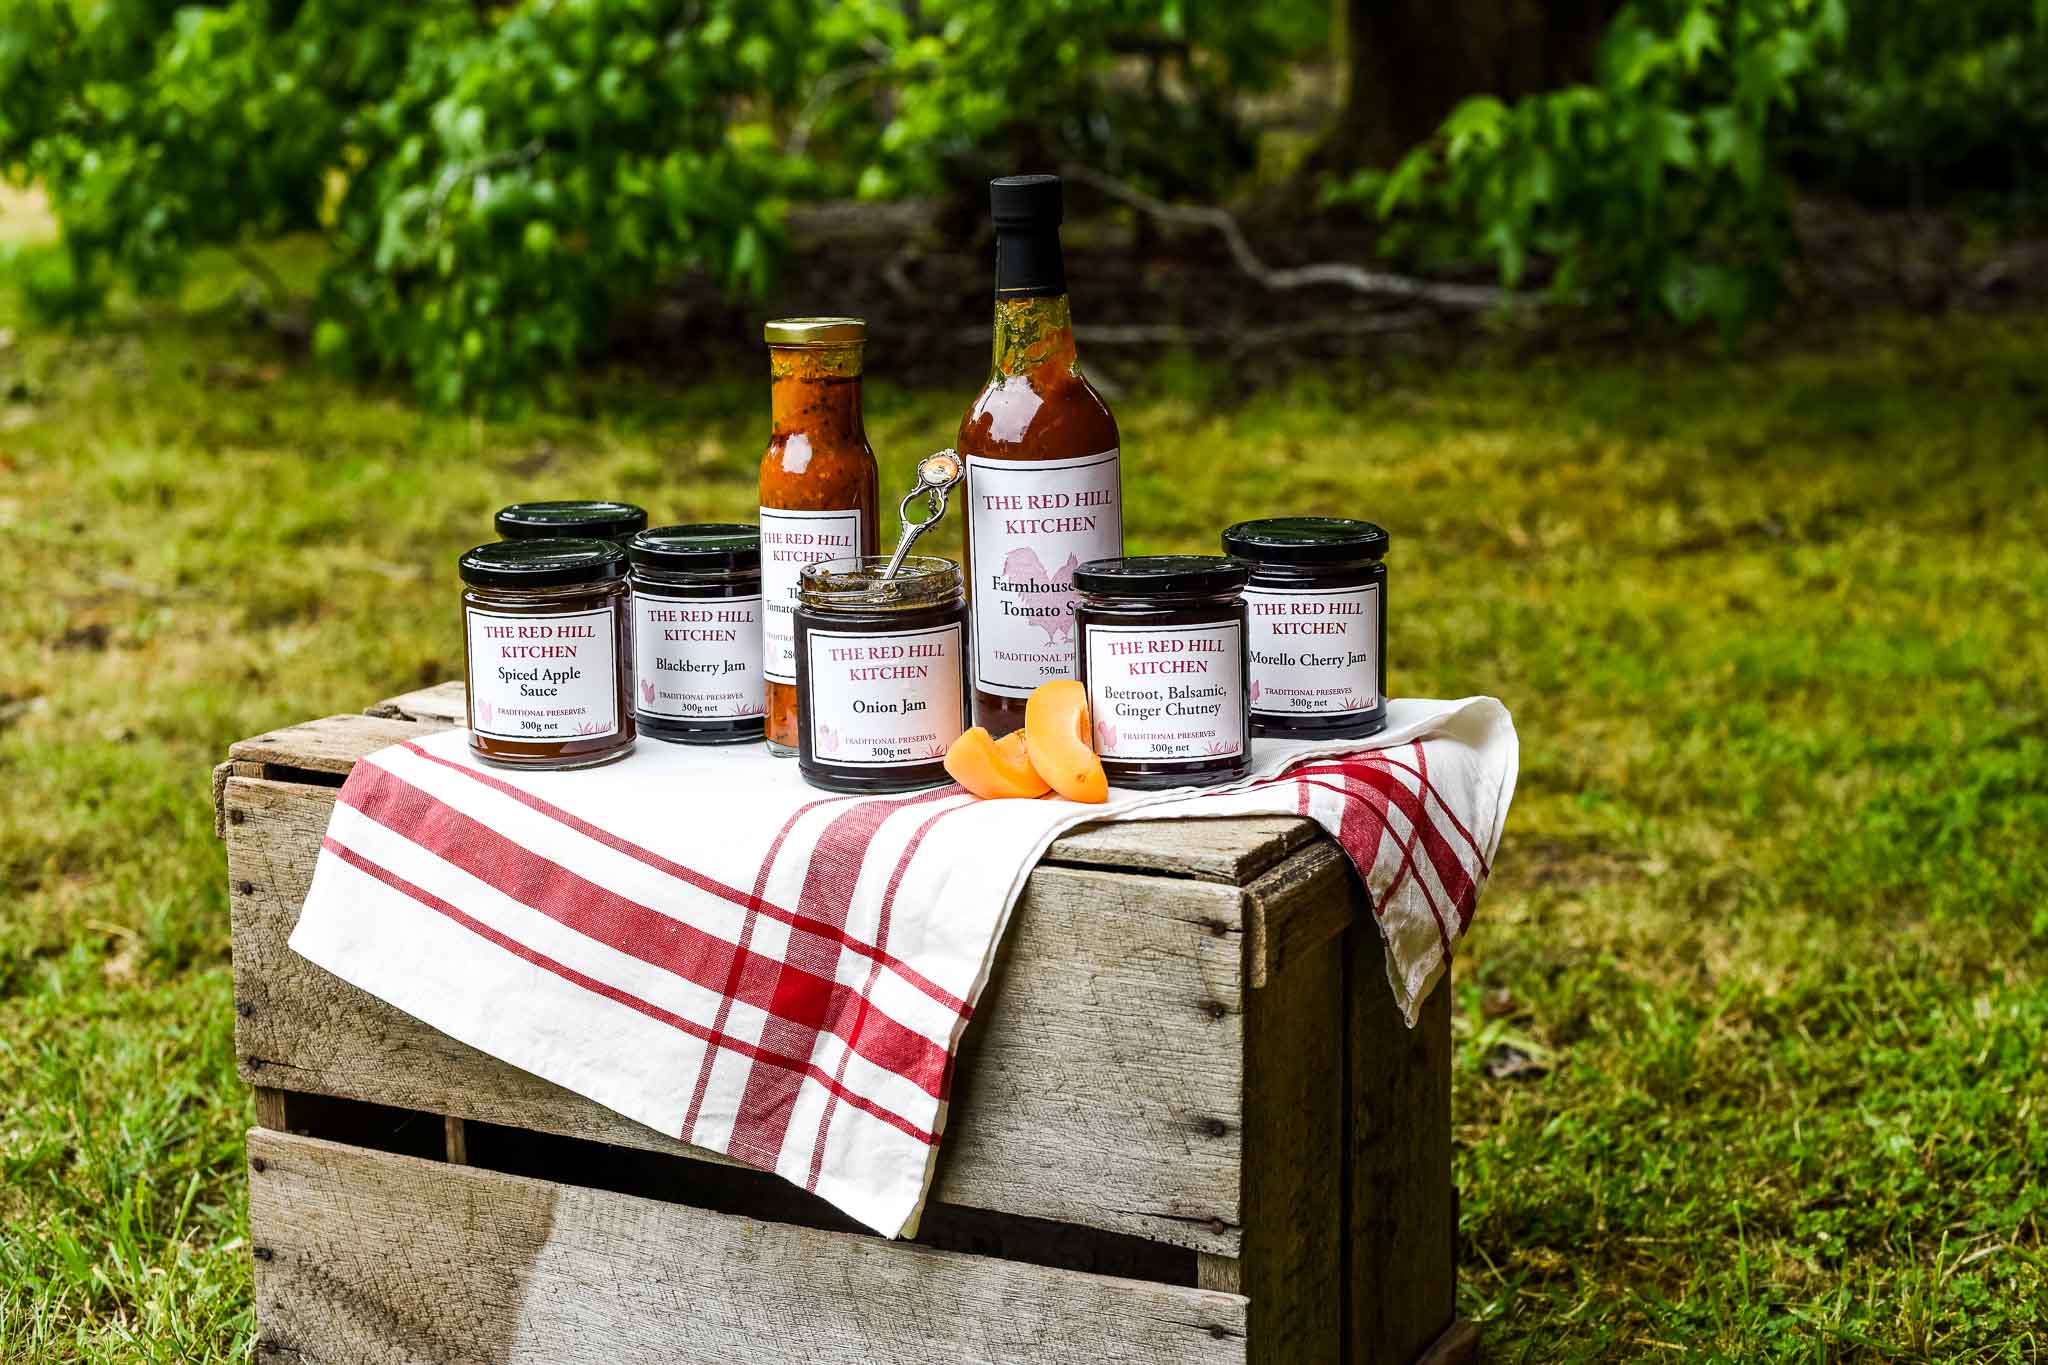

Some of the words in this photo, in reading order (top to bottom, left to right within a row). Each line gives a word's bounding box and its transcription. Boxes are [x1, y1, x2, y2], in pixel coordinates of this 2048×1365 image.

[983, 495, 1022, 510] THE
[1028, 493, 1069, 509] RED
[1075, 490, 1112, 507] HILL
[1005, 515, 1096, 534] KITCHEN
[764, 532, 782, 544] THE
[785, 533, 814, 545] RED
[818, 534, 852, 546] HILL
[773, 550, 835, 562] KITCHEN
[1001, 600, 1060, 617] Tomato
[1253, 603, 1286, 615] THE
[1291, 603, 1324, 614] RED
[1329, 603, 1364, 615] HILL
[648, 610, 677, 622] THE
[680, 611, 713, 622] RED
[718, 611, 754, 622] HILL
[483, 626, 514, 638] THE
[518, 626, 552, 638] RED
[557, 626, 595, 638] HILL
[1272, 622, 1347, 634] KITCHEN
[664, 630, 736, 641] KITCHEN
[501, 646, 577, 658] KITCHEN
[828, 647, 864, 661] THE
[868, 646, 904, 659] RED
[909, 644, 944, 658] HILL
[1109, 641, 1143, 655] THE
[1148, 640, 1184, 653] RED
[1189, 640, 1224, 652] HILL
[994, 650, 1061, 662] TRADITIONAL
[1250, 651, 1295, 666] Morello
[1300, 653, 1344, 668] Cherry
[1347, 651, 1367, 667] Jam
[656, 657, 719, 675] Blackberry
[723, 660, 745, 674] Jam
[1040, 666, 1069, 675] 550mL
[1128, 661, 1208, 675] KITCHEN
[498, 666, 538, 683] Spiced
[542, 666, 581, 684] Apple
[850, 666, 928, 680] KITCHEN
[520, 684, 557, 696] Sauce
[660, 691, 704, 700] TRADITIONAL
[1105, 686, 1163, 700] Beetroot,
[1168, 684, 1227, 699] Balsamic,
[1265, 687, 1314, 696] TRADITIONAL
[681, 703, 702, 713] 300g
[705, 704, 718, 712] net
[853, 700, 897, 713] Onion
[901, 699, 926, 714] Jam
[1290, 699, 1312, 709] 300g
[498, 707, 545, 717] TRADITIONAL
[547, 708, 586, 717] PRESERVES
[1115, 703, 1161, 720] Ginger
[1166, 703, 1221, 716] Chutney
[520, 721, 541, 731] 300g
[845, 735, 896, 745] TRADITIONAL
[899, 733, 936, 744] PRESERVES
[1123, 732, 1175, 740] TRADITIONAL
[1178, 730, 1216, 739] PRESERVES
[872, 747, 894, 757] 300g
[897, 747, 911, 755] net
[1150, 744, 1173, 754] 300g
